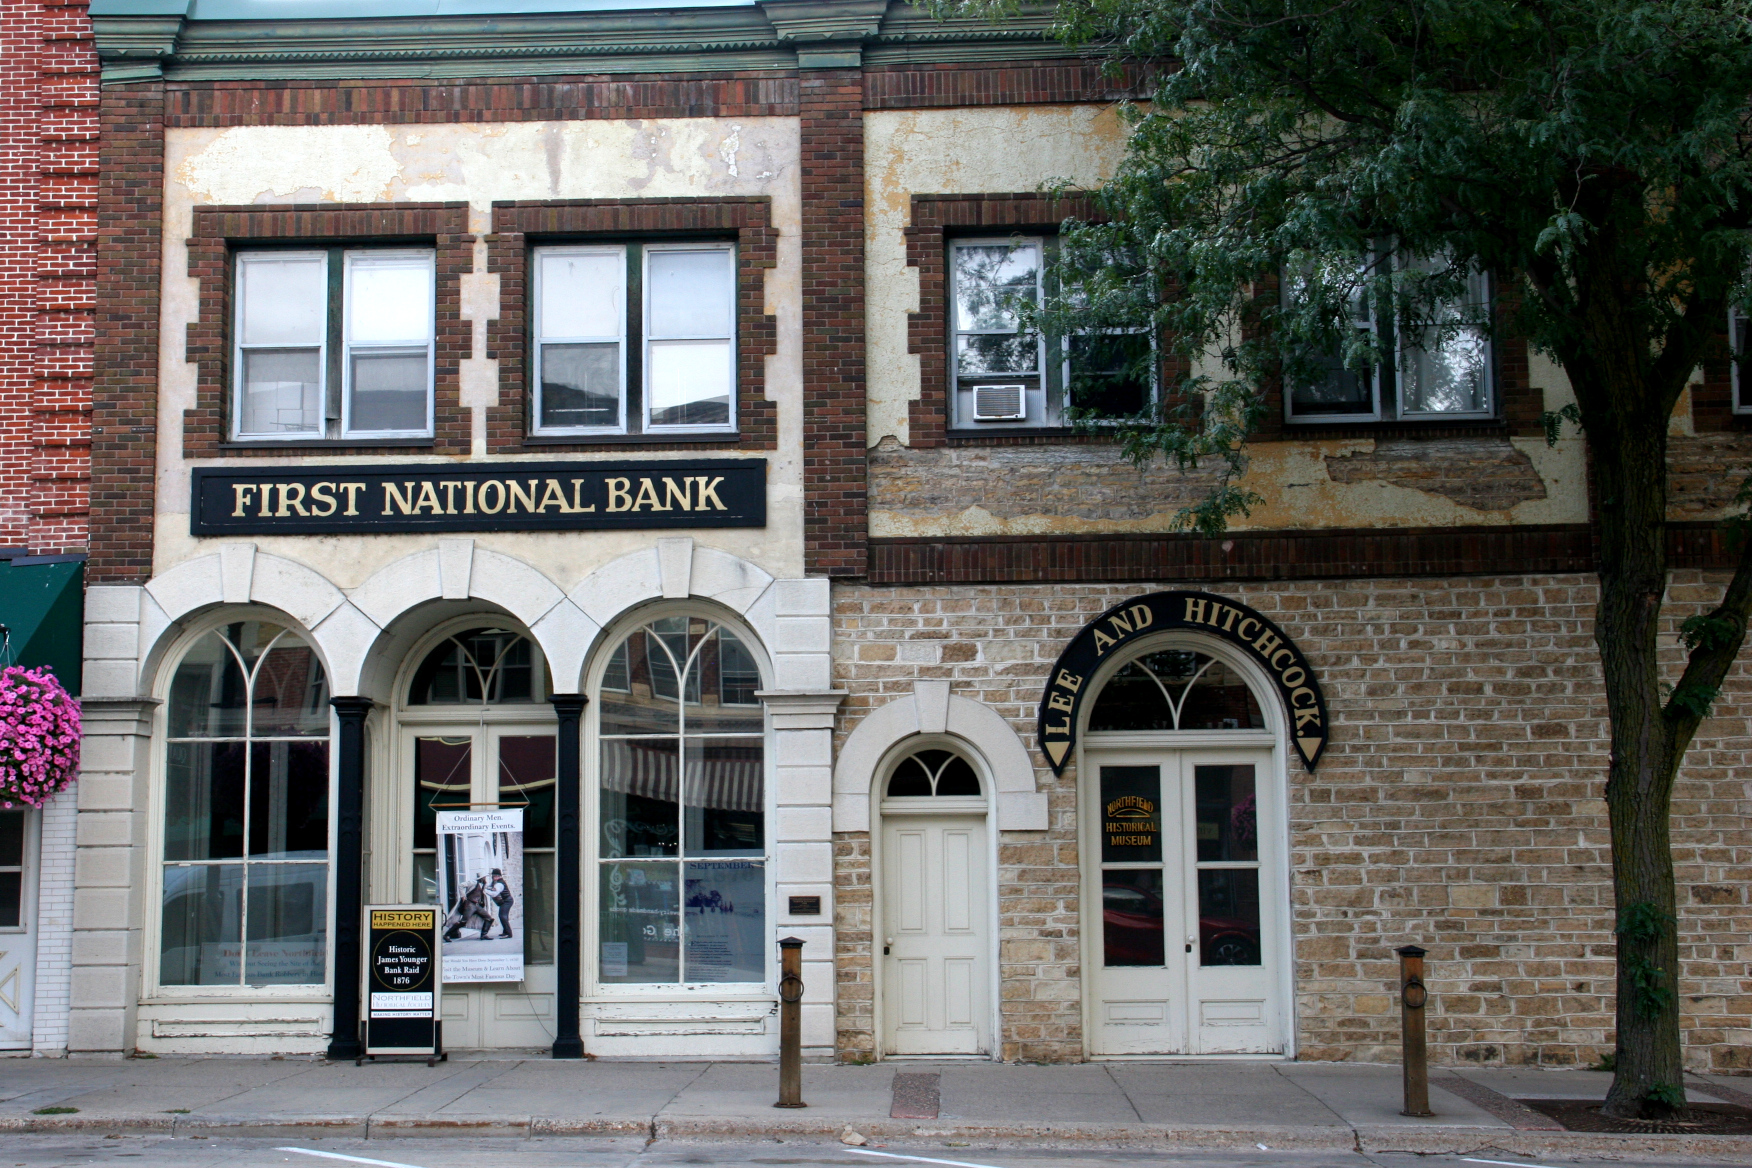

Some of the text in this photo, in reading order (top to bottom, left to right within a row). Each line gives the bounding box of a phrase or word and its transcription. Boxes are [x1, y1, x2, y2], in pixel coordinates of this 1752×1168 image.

[231, 476, 728, 518] FIRST NATIONAL BANK
[1046, 597, 1321, 737] LEE AND HITCHCOCK.
[1107, 796, 1154, 813] NORTHFIELD
[1106, 822, 1157, 832] HISTORICAL
[1111, 836, 1152, 845] MUSEUM
[374, 913, 431, 921] HISTORY
[377, 956, 428, 965] James Younger
[373, 994, 432, 1002] NORTHFIELD
